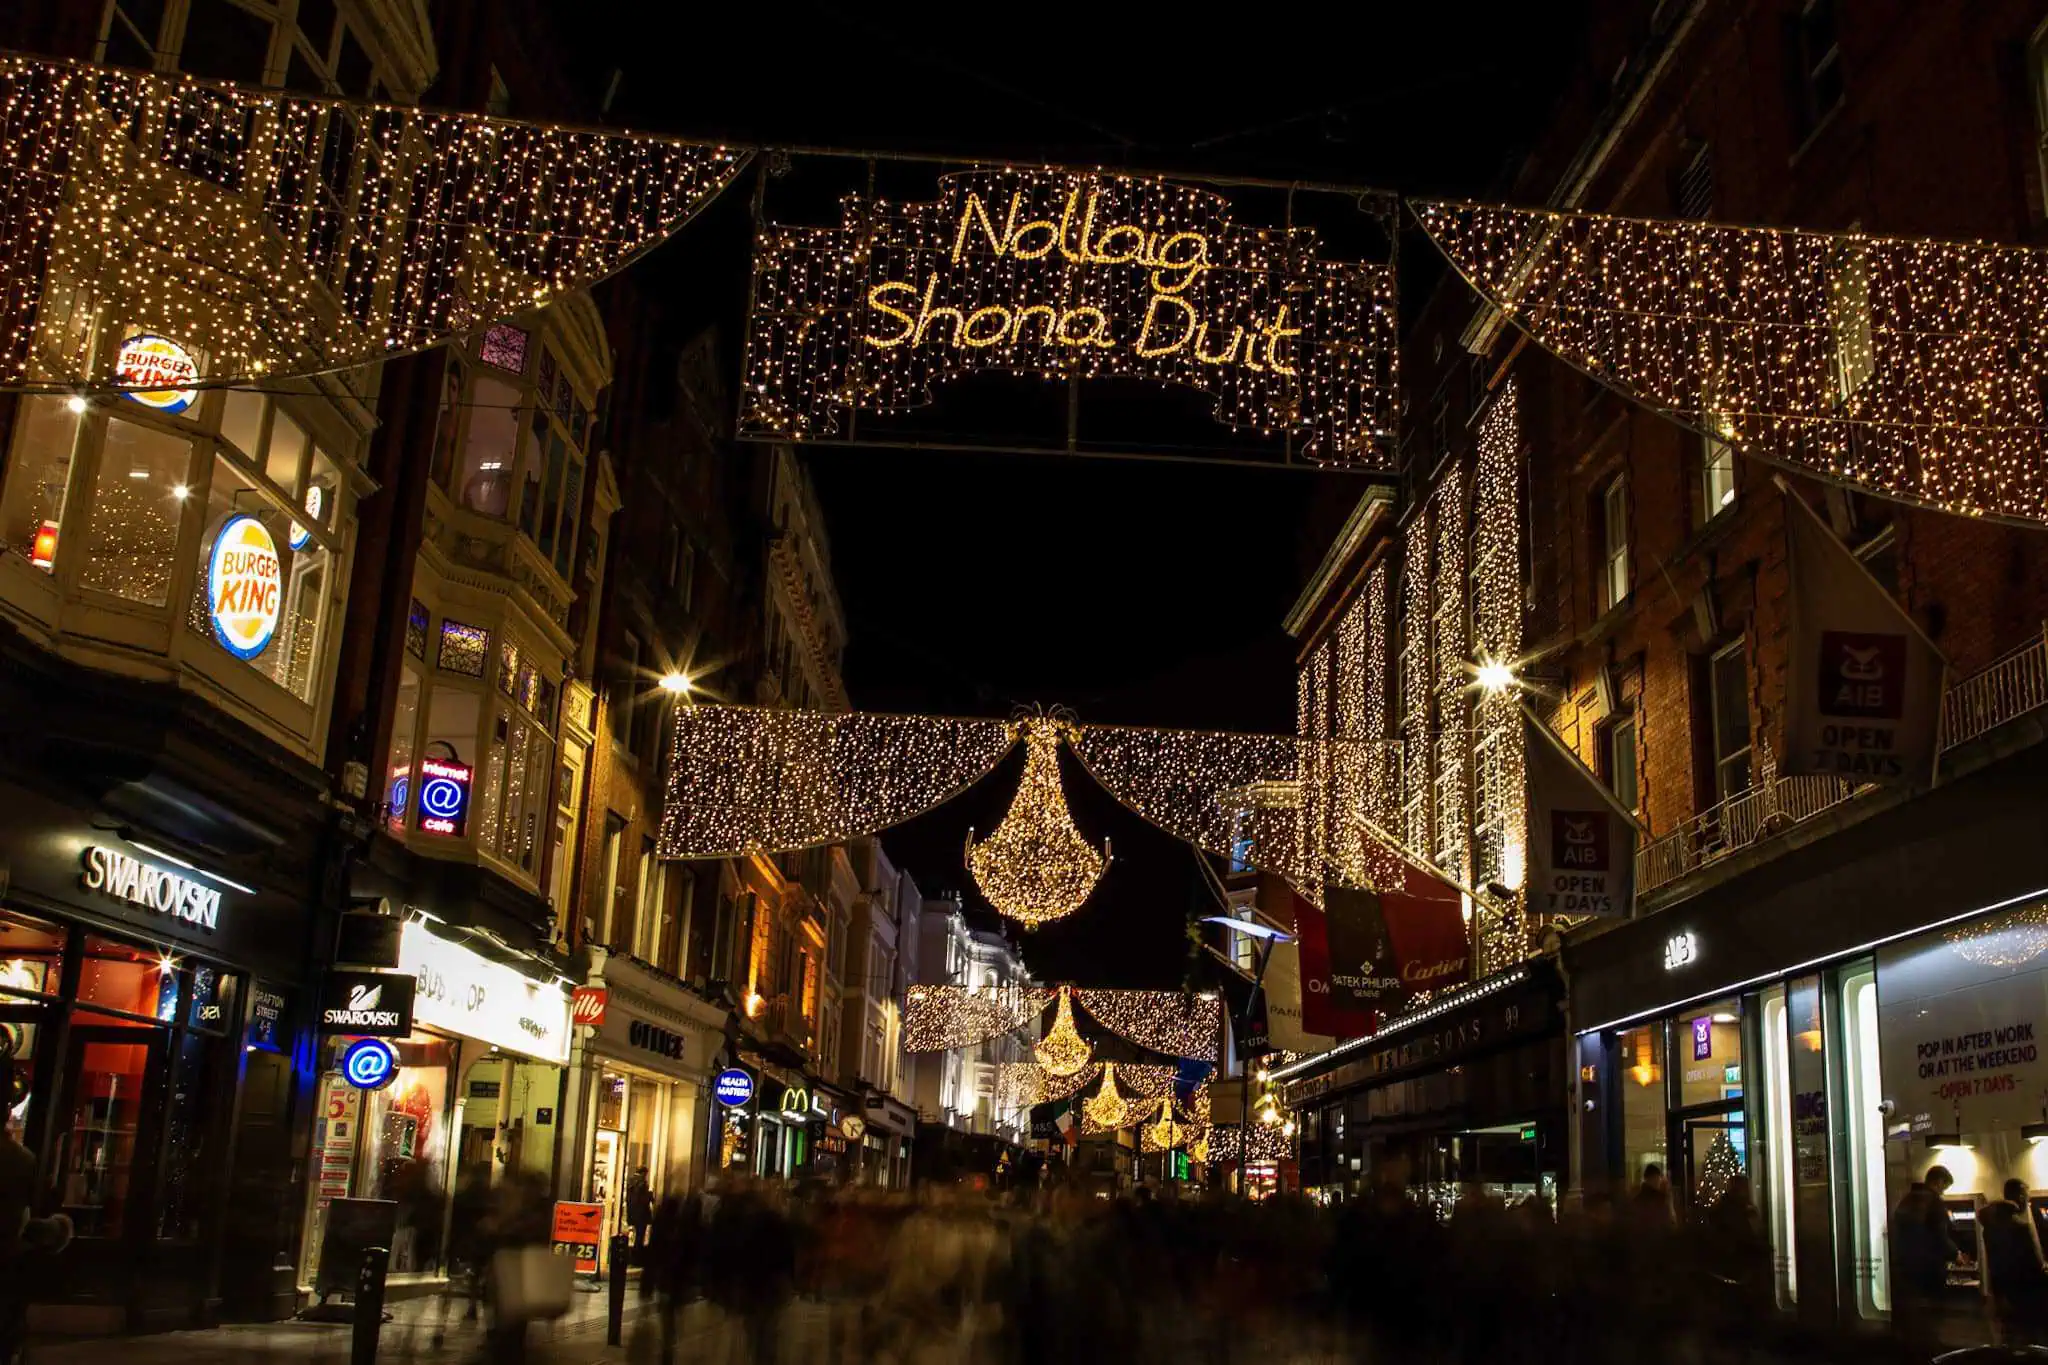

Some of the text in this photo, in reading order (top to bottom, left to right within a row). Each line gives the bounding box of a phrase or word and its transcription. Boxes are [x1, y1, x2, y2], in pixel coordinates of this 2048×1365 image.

[952, 191, 1212, 293] Nollaig
[864, 271, 1301, 375] Shona Duit
[123, 352, 193, 375] BURGER
[222, 552, 278, 579] BURGER
[217, 579, 277, 616] KING
[1832, 683, 1884, 708] AIB
[1822, 725, 1895, 749] OPEN
[1837, 752, 1902, 775] DAYS
[1563, 845, 1598, 865] AIB
[86, 846, 222, 930] SWAROVSKI
[1555, 875, 1605, 893] OPEN
[1547, 893, 1611, 911] 7 DAYS
[1403, 956, 1468, 981] Cartier
[324, 1009, 400, 1027] SWAROVSKI
[574, 994, 604, 1022] illy
[1918, 1023, 2034, 1058] POP IN AFTER WORK
[1918, 1044, 2038, 1079] OR AT THE WEEKEND
[720, 1075, 748, 1088] HEALTH
[1940, 1074, 2015, 1100] OPEN 7 DAYS
